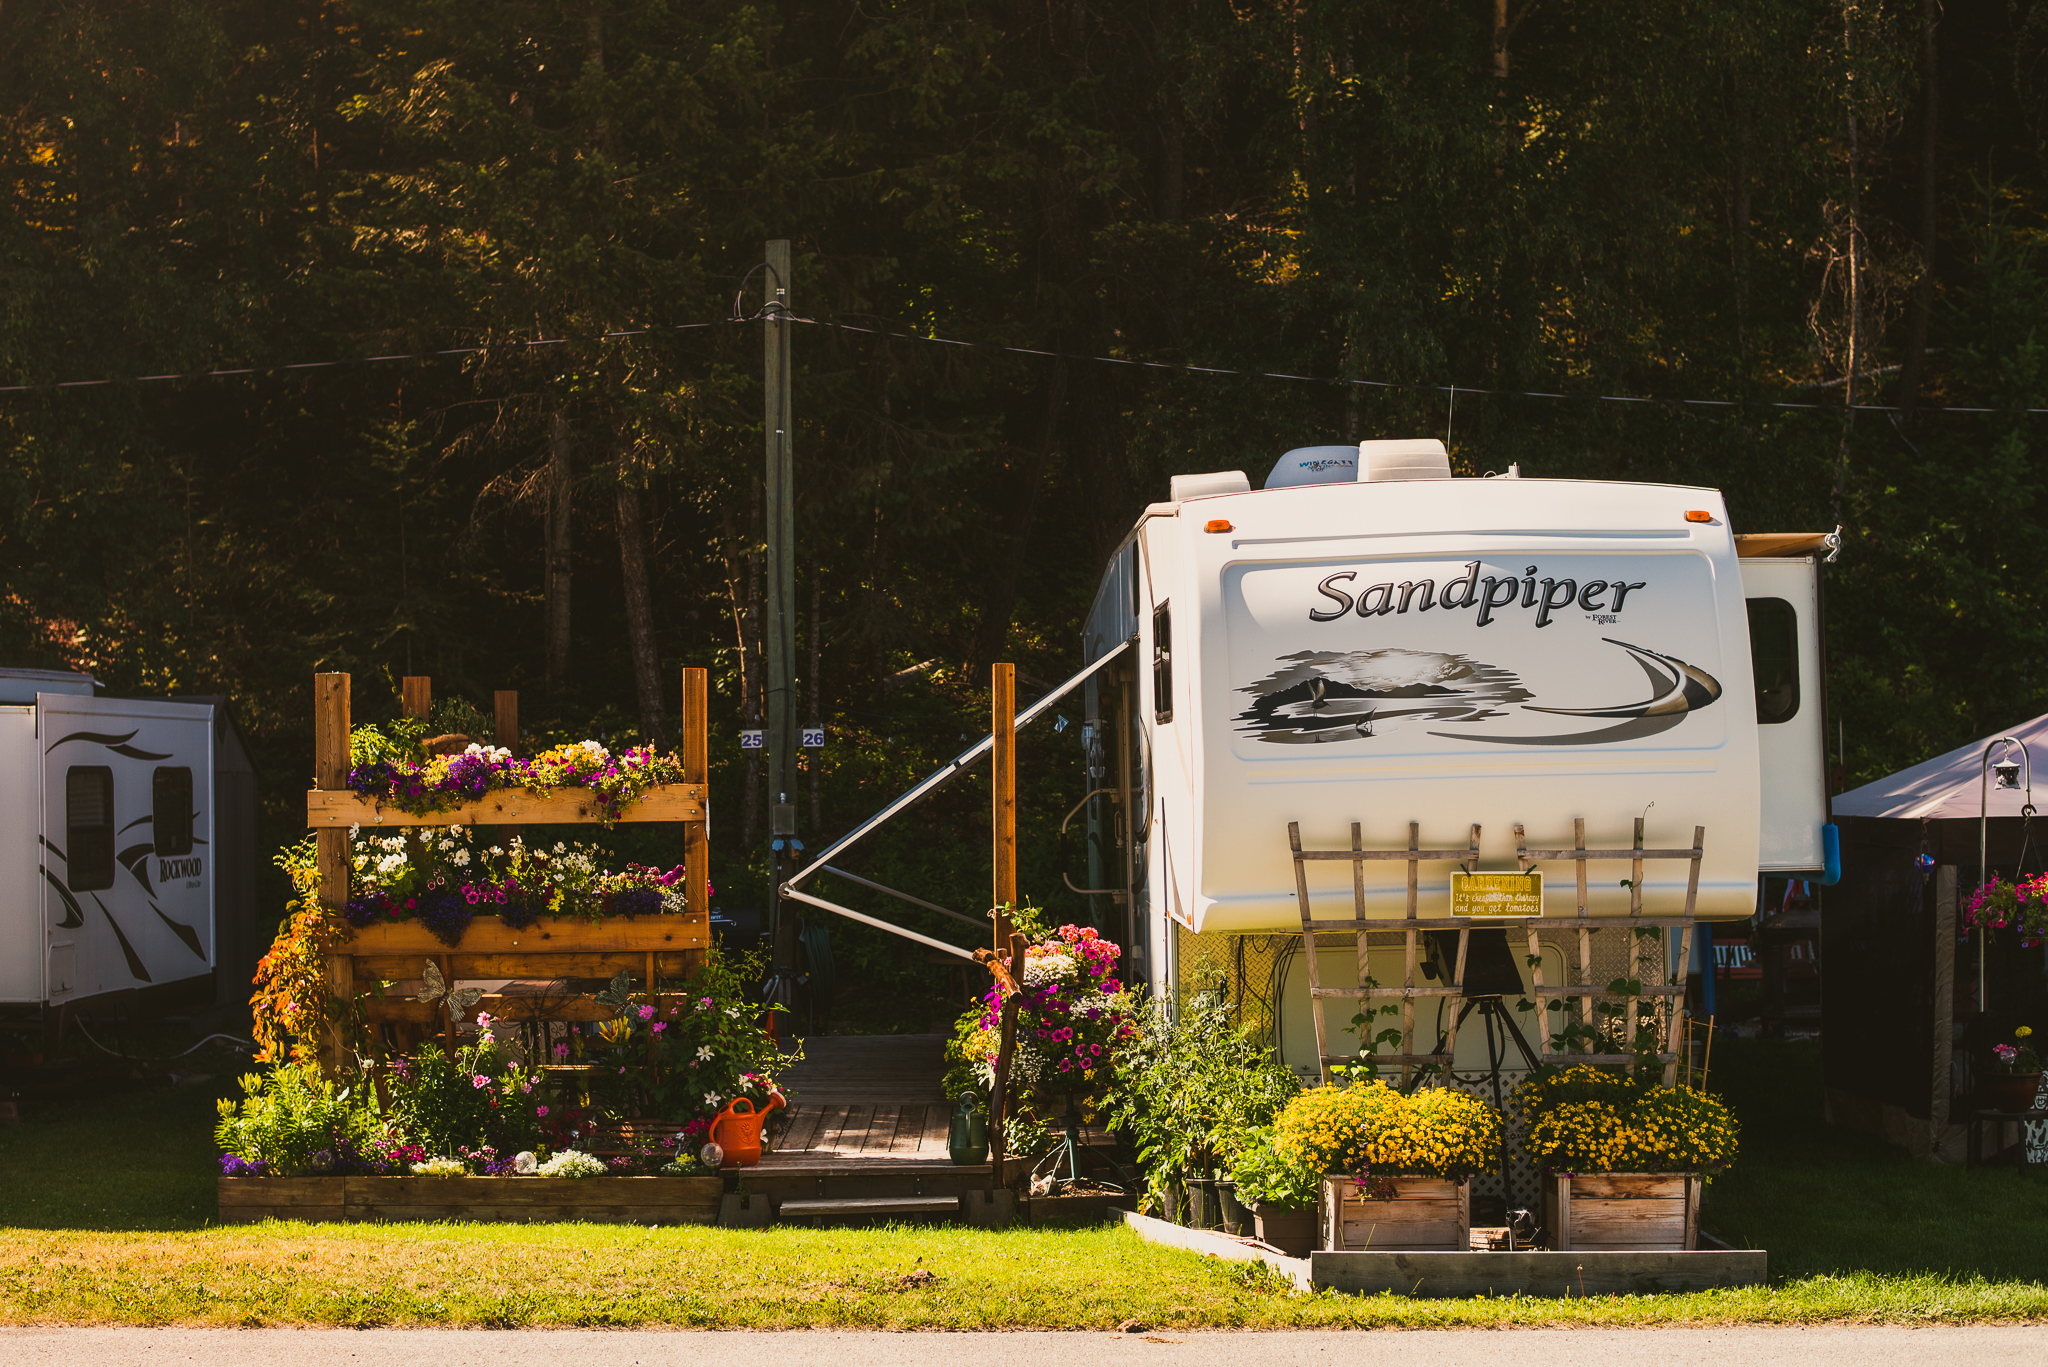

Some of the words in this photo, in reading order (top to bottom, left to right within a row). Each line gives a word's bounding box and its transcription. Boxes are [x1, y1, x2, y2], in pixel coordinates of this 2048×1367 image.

[1308, 560, 1646, 628] Sandpiper
[741, 734, 762, 747] 25
[803, 733, 824, 746] 26
[160, 857, 202, 883] ROCKWOOD
[1461, 875, 1532, 892] GARDENING
[1454, 902, 1469, 913] and
[1471, 905, 1485, 915] you
[1488, 903, 1502, 915] get
[1505, 902, 1540, 913] tomatoes
